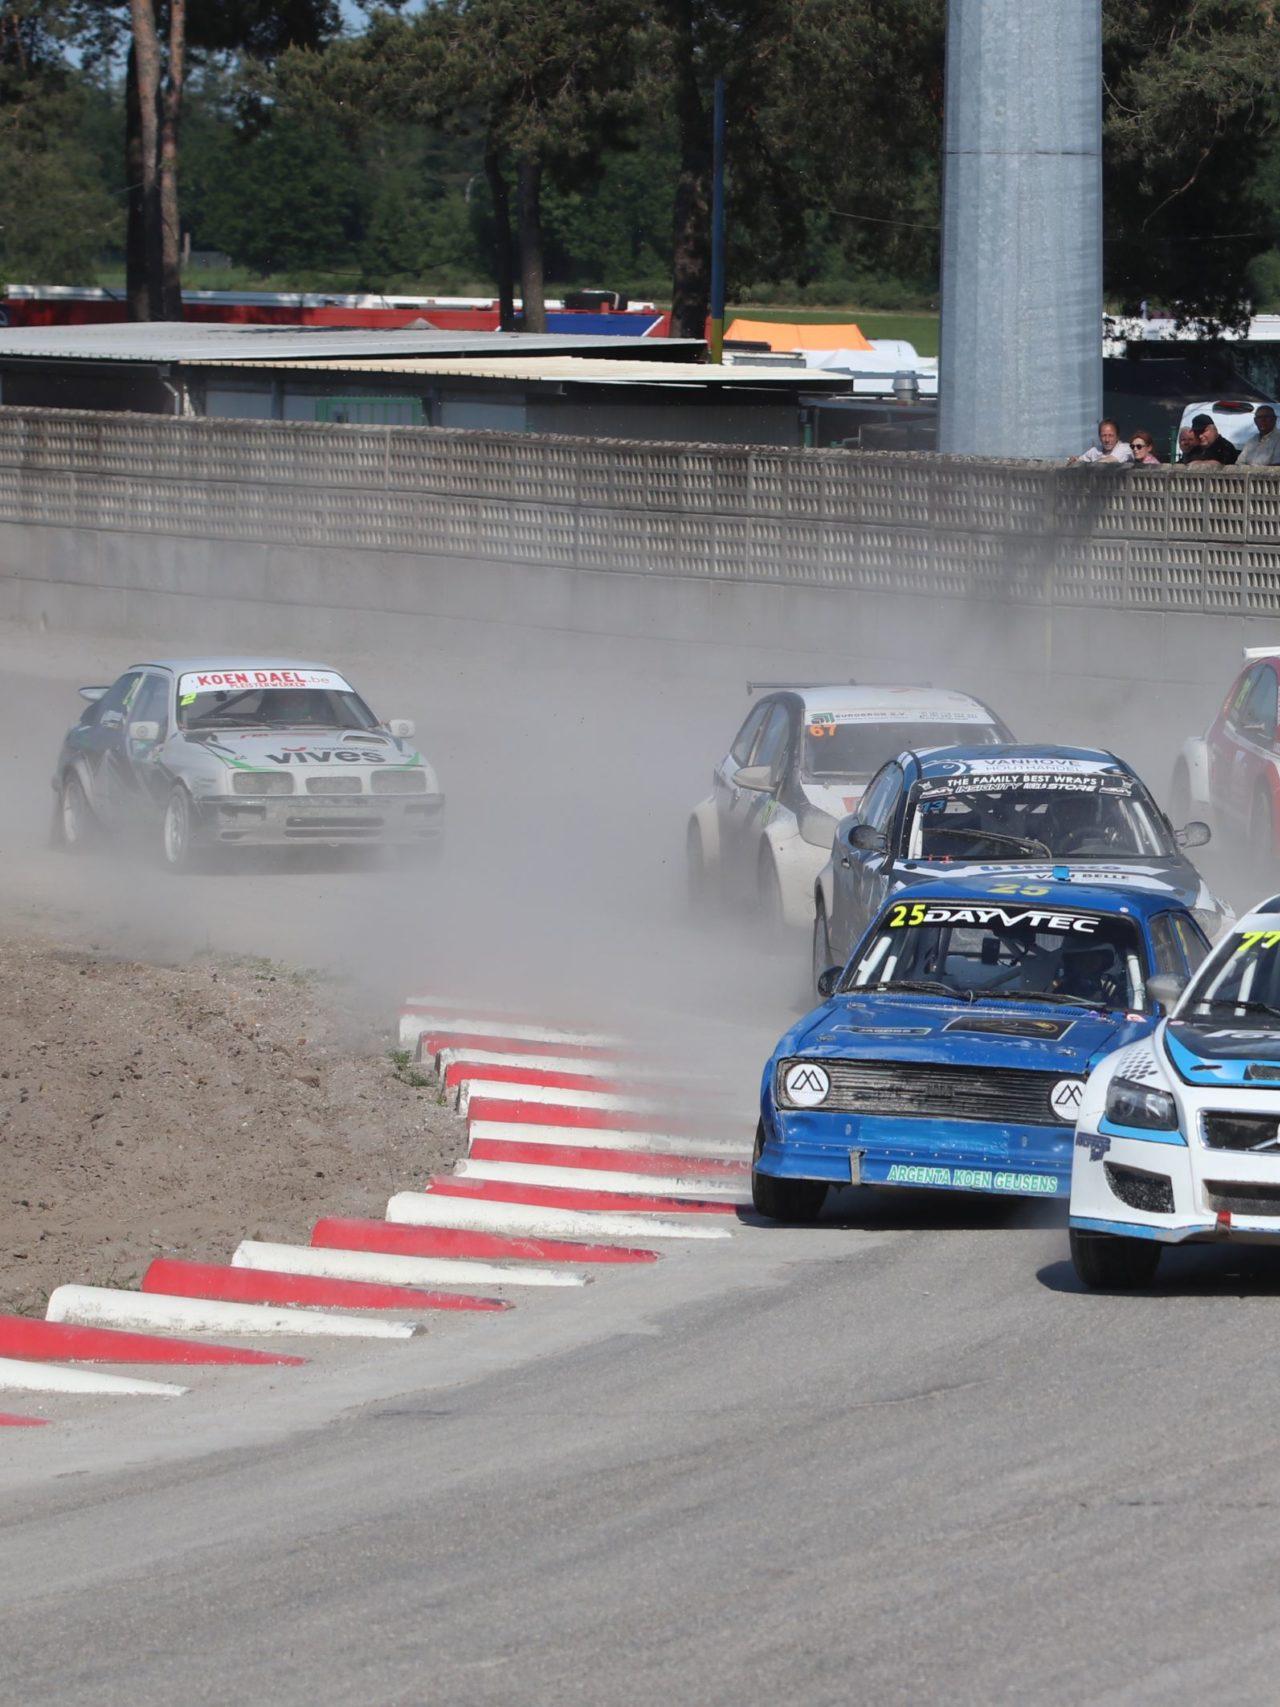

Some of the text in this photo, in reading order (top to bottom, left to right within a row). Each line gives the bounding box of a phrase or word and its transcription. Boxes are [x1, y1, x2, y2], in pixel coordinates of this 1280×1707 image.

[197, 673, 247, 686] KOEN
[180, 693, 196, 706] 2
[809, 723, 837, 737] 67
[265, 751, 386, 764] vives
[947, 778, 969, 786] THE
[1054, 776, 1097, 785] WRAPS
[986, 884, 1050, 895] 25
[890, 905, 925, 927] 25
[887, 1164, 1058, 1193] ARGENTA KOEN GEUSENS
